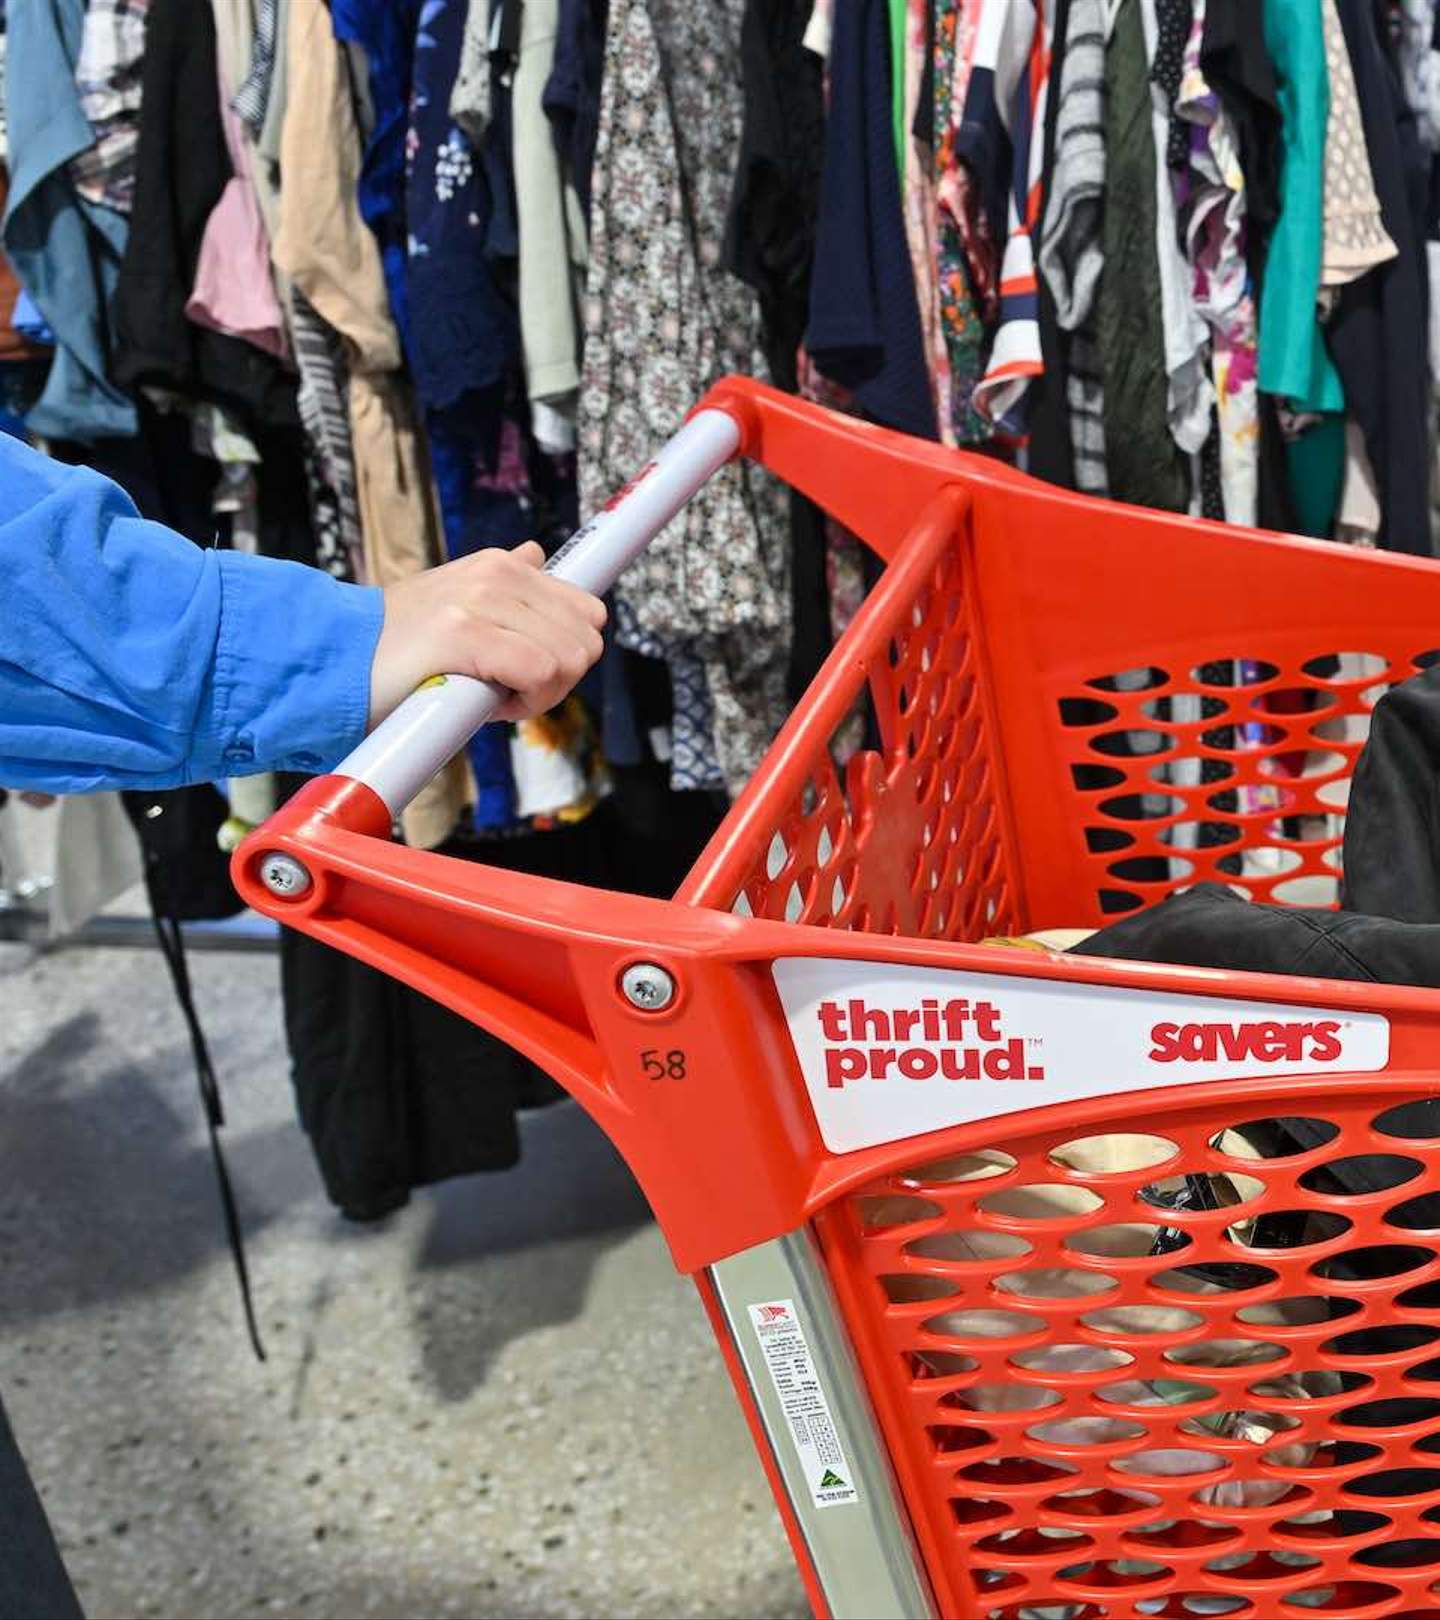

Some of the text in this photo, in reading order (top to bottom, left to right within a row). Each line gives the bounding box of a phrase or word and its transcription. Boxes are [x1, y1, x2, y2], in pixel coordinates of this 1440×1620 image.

[817, 998, 1002, 1042] thrift
[1148, 1021, 1342, 1062] savers
[640, 1050, 685, 1080] 58
[825, 1038, 1044, 1088] proud.
